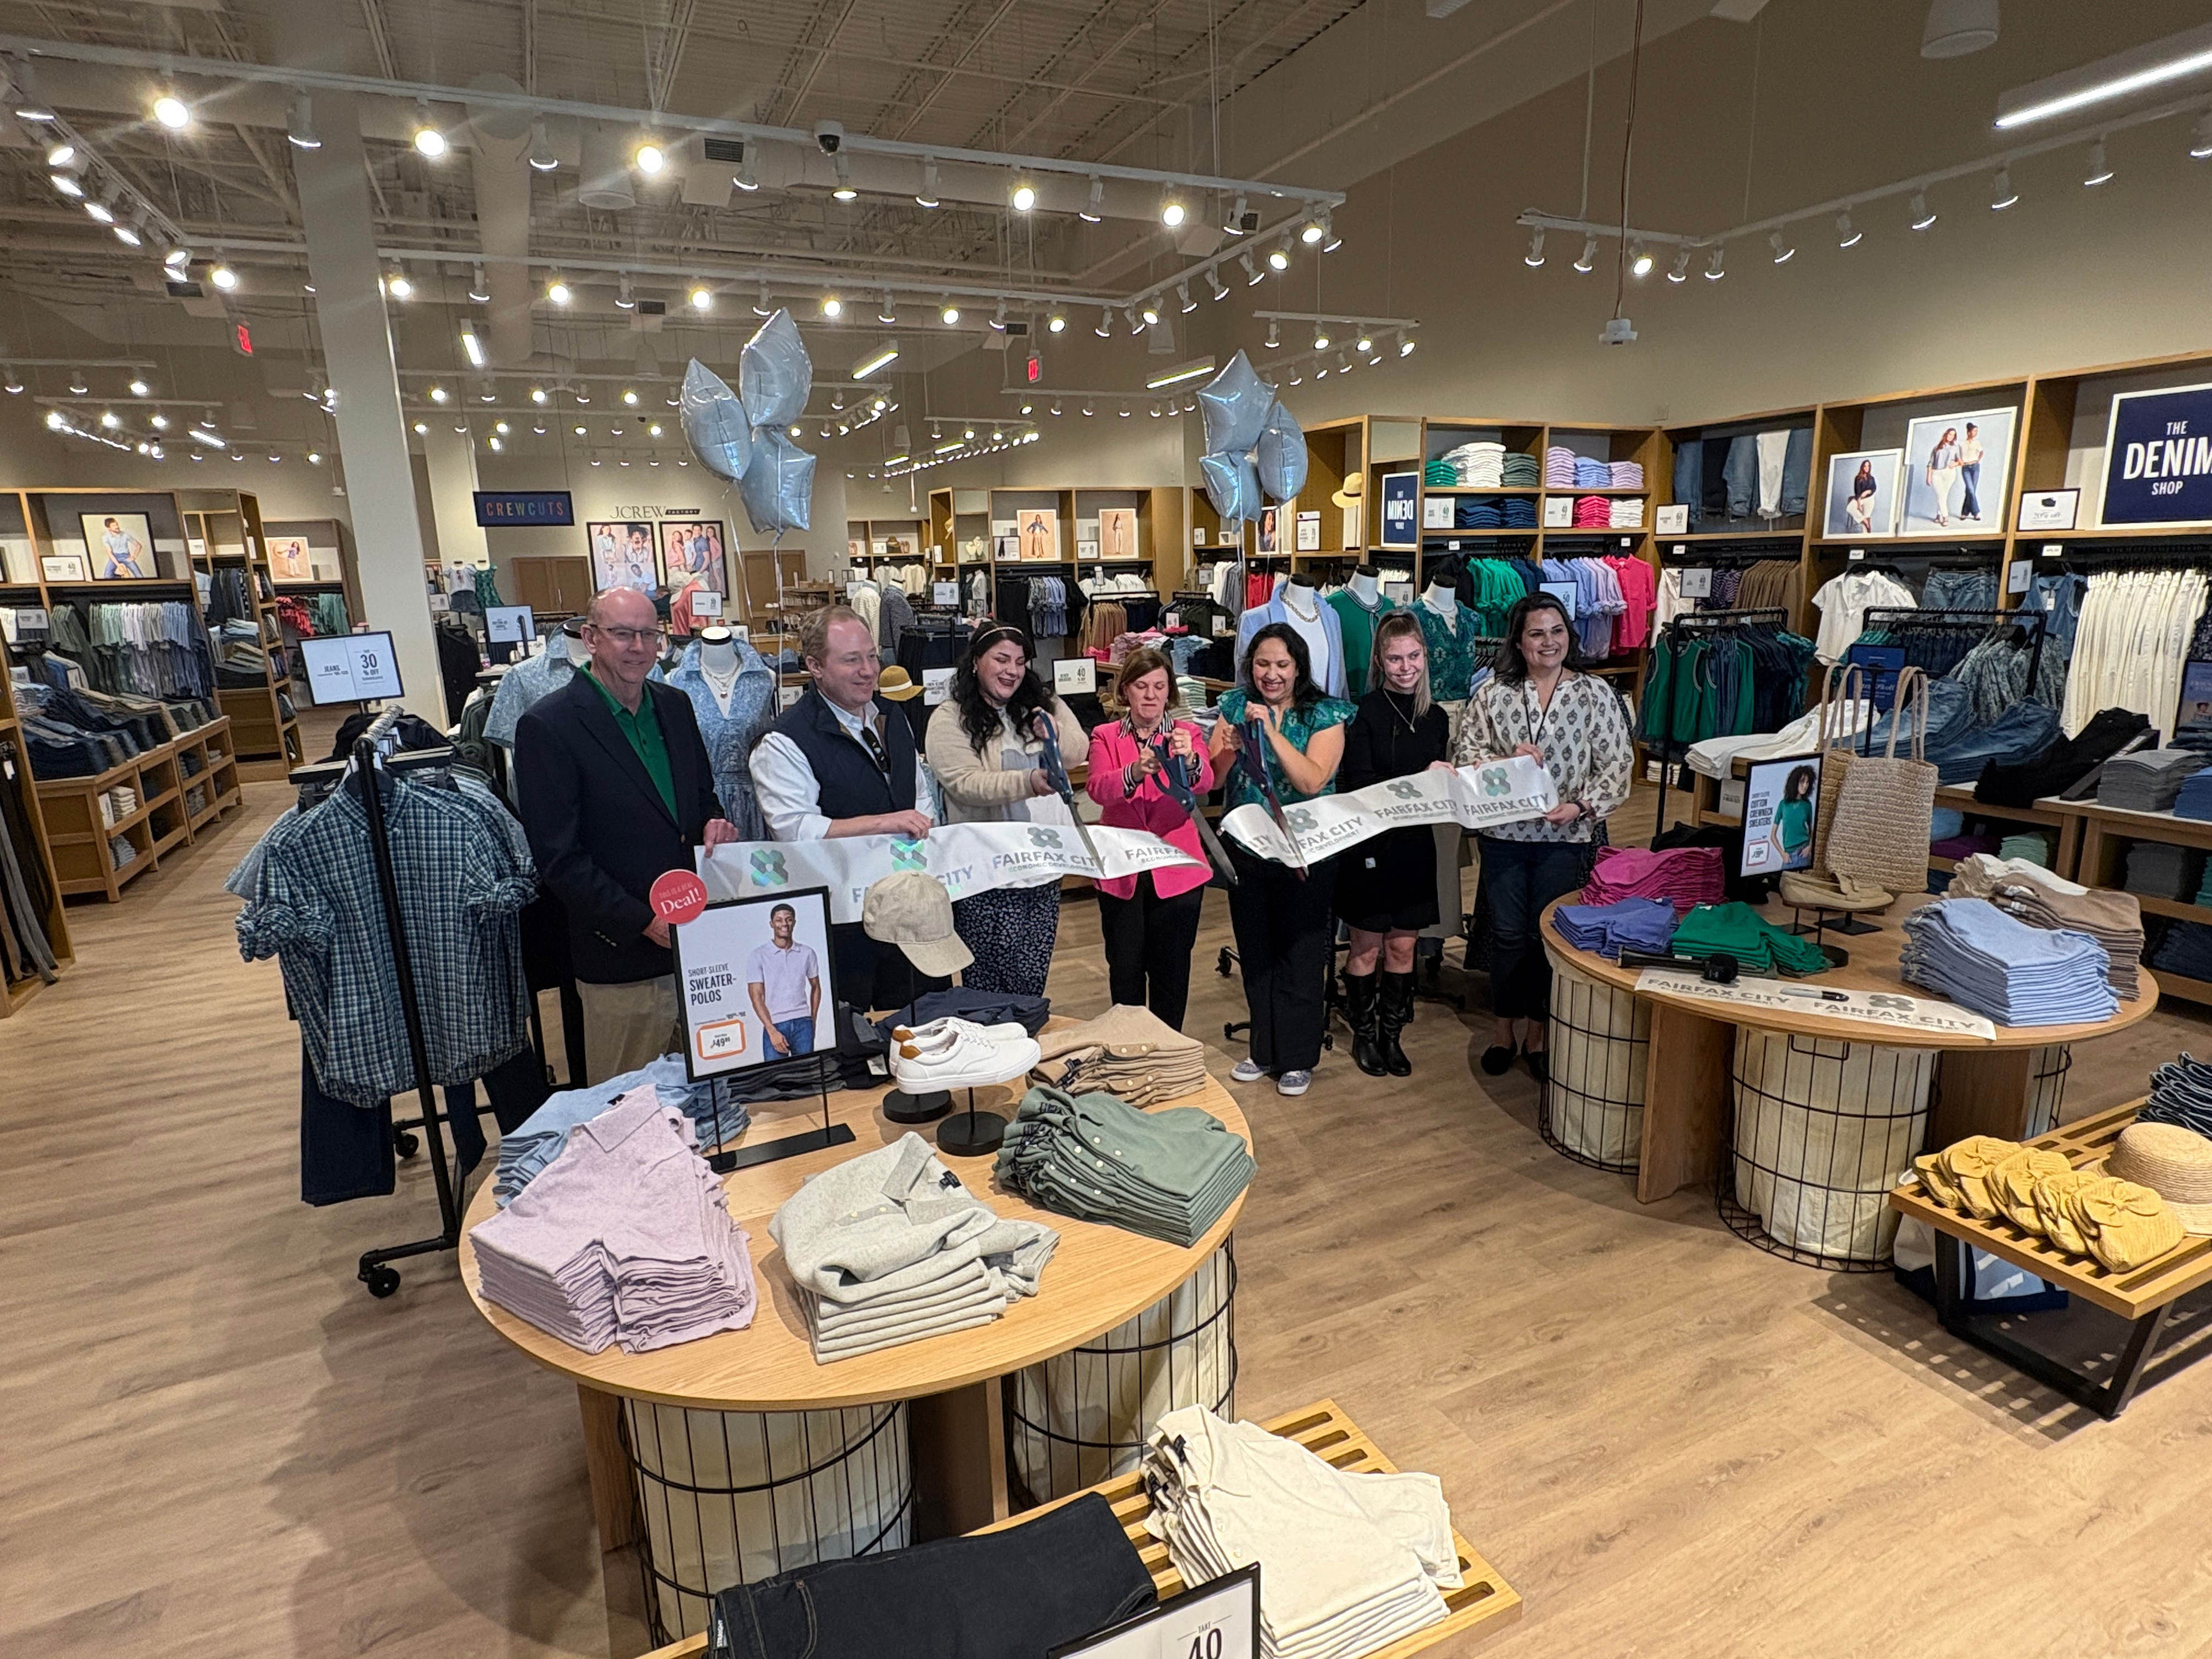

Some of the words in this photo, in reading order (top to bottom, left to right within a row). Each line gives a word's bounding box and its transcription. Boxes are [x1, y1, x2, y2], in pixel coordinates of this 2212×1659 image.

[2166, 421, 2189, 436] THE
[2123, 437, 2212, 479] DENIM
[2152, 481, 2184, 495] SHOP
[486, 501, 563, 516] CREWCUTS
[610, 505, 667, 519] J.CREW
[360, 653, 377, 669] 30
[1077, 668, 1086, 677] 40
[1374, 802, 1433, 818] FAIRFAX
[1463, 800, 1519, 816] FAIRFAX
[1518, 793, 1549, 808] CITY
[1329, 816, 1363, 836] CITY
[992, 851, 1066, 869] FAIRFAX
[1125, 847, 1183, 860] FAIRFA
[1008, 863, 1048, 872] ECONOMIC
[661, 888, 702, 914] Deal!
[688, 967, 707, 977] SHORT
[709, 963, 729, 974] SLEEVE
[691, 989, 721, 1006] POLOS
[1647, 978, 1733, 997] FAIRFAX
[1741, 992, 1790, 1004] CITY
[1814, 1002, 1911, 1021] FAIRFAX
[1919, 1016, 1976, 1029] CITY
[1188, 1628, 1222, 1659] 40
